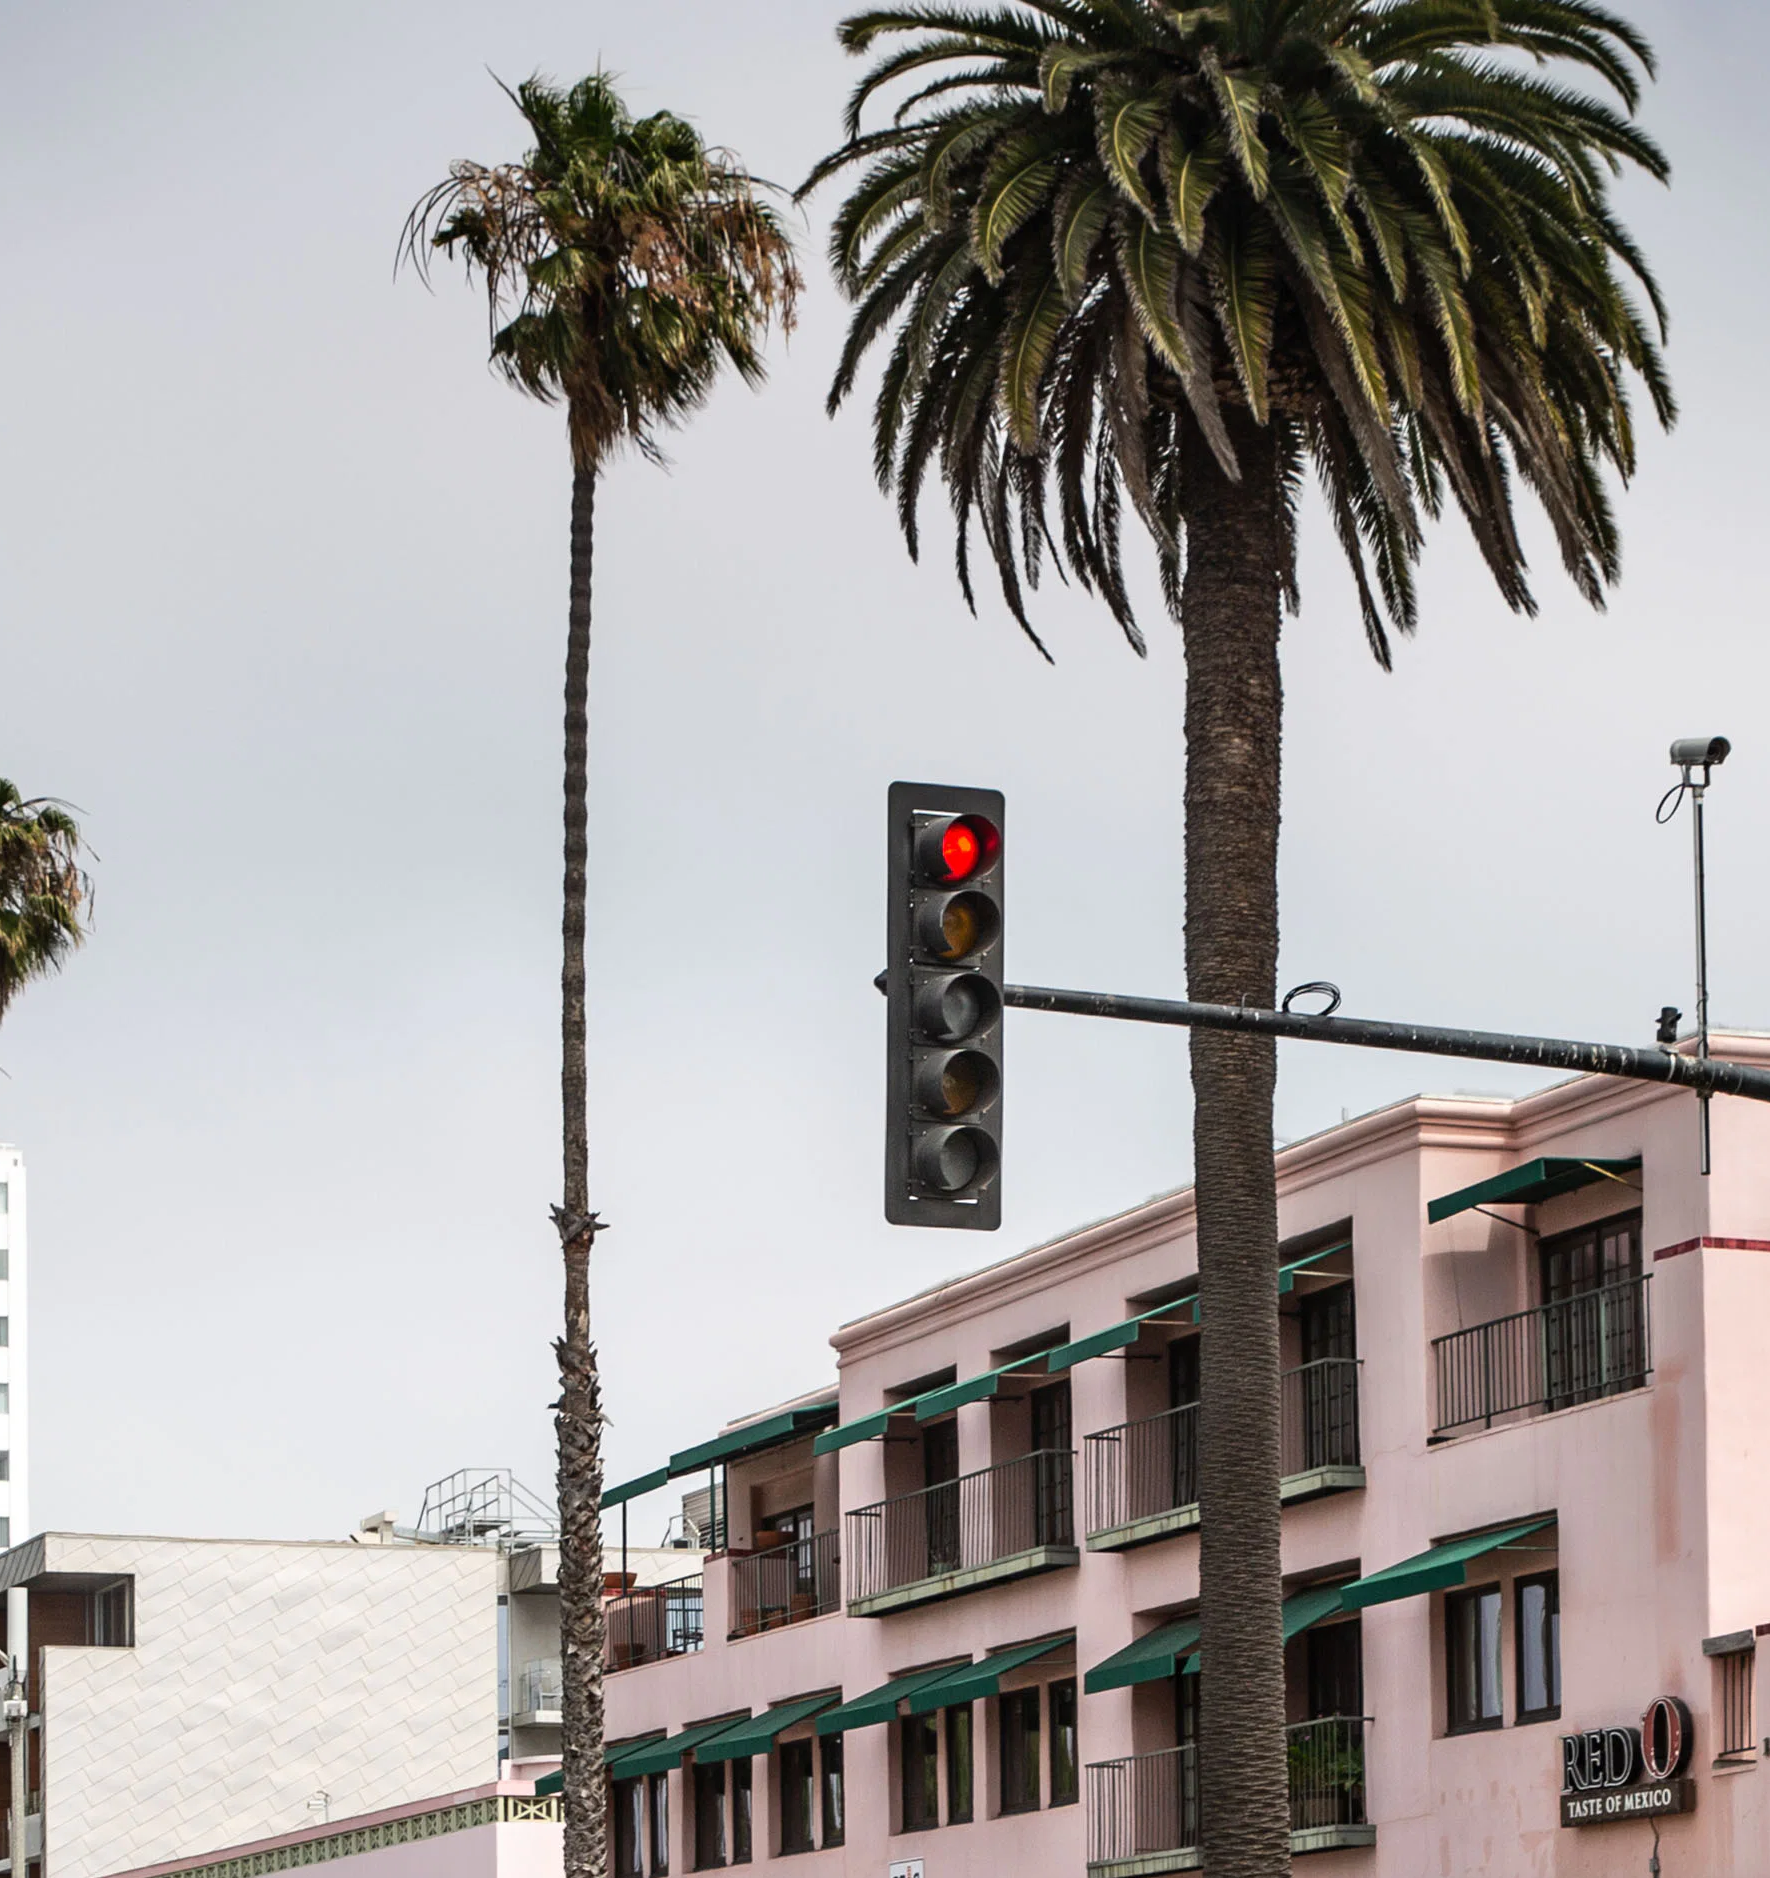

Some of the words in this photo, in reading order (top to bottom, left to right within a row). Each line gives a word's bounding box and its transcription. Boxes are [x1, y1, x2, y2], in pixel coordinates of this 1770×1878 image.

[1559, 1726, 1636, 1793] RED
[1640, 1695, 1684, 1780] O
[1567, 1799, 1603, 1819] TASTE
[1605, 1796, 1622, 1815] OF
[1624, 1788, 1672, 1812] MEXICO
